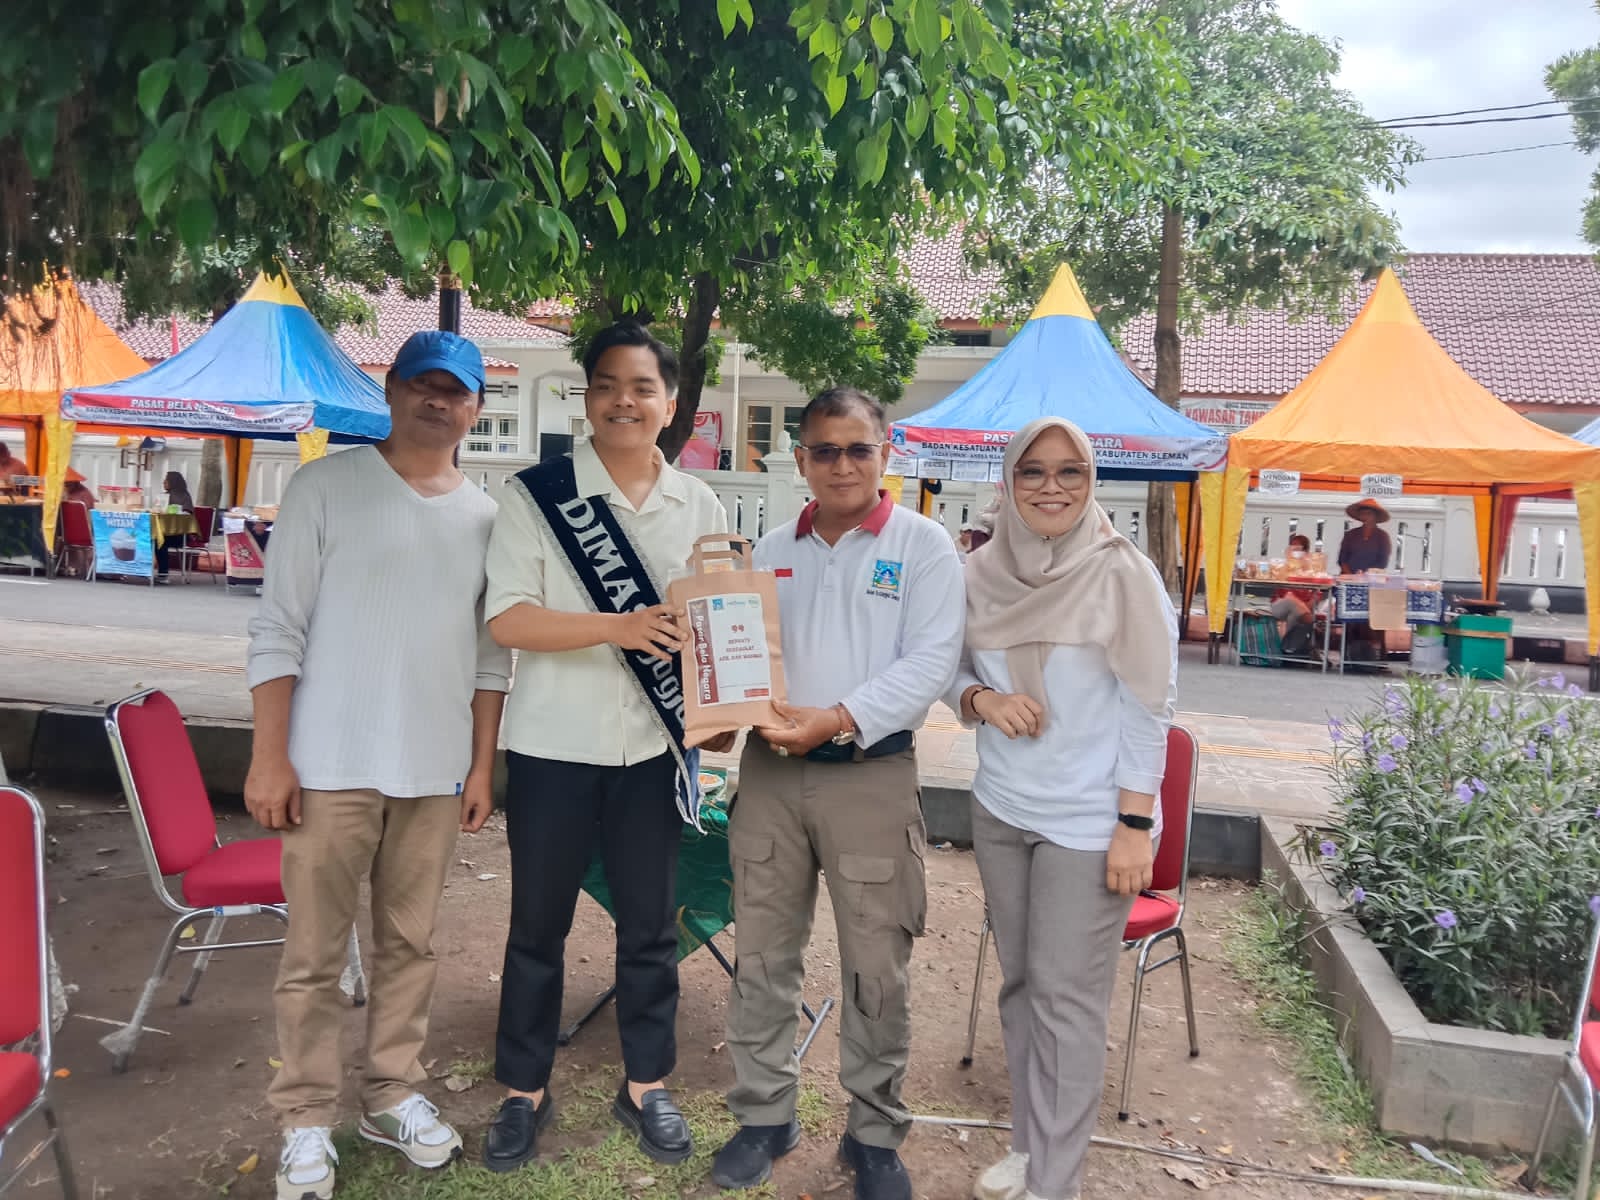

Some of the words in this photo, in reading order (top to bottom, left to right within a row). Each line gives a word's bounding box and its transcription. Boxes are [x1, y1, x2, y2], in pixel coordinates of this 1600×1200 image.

[130, 399, 164, 409] PASAR
[168, 400, 193, 411] BELA
[983, 432, 1014, 443] PAS
[921, 442, 950, 450] BADAN
[953, 444, 998, 453] KESATUAN
[1095, 450, 1151, 460] KABUPATEN
[1151, 453, 1189, 461] SLEMAN
[1368, 476, 1394, 485] PUKIS
[1367, 486, 1395, 496] JADUL
[555, 496, 648, 614] DIMA
[695, 615, 706, 642] Pasar
[698, 642, 708, 664] Bela
[701, 665, 713, 701] Negara
